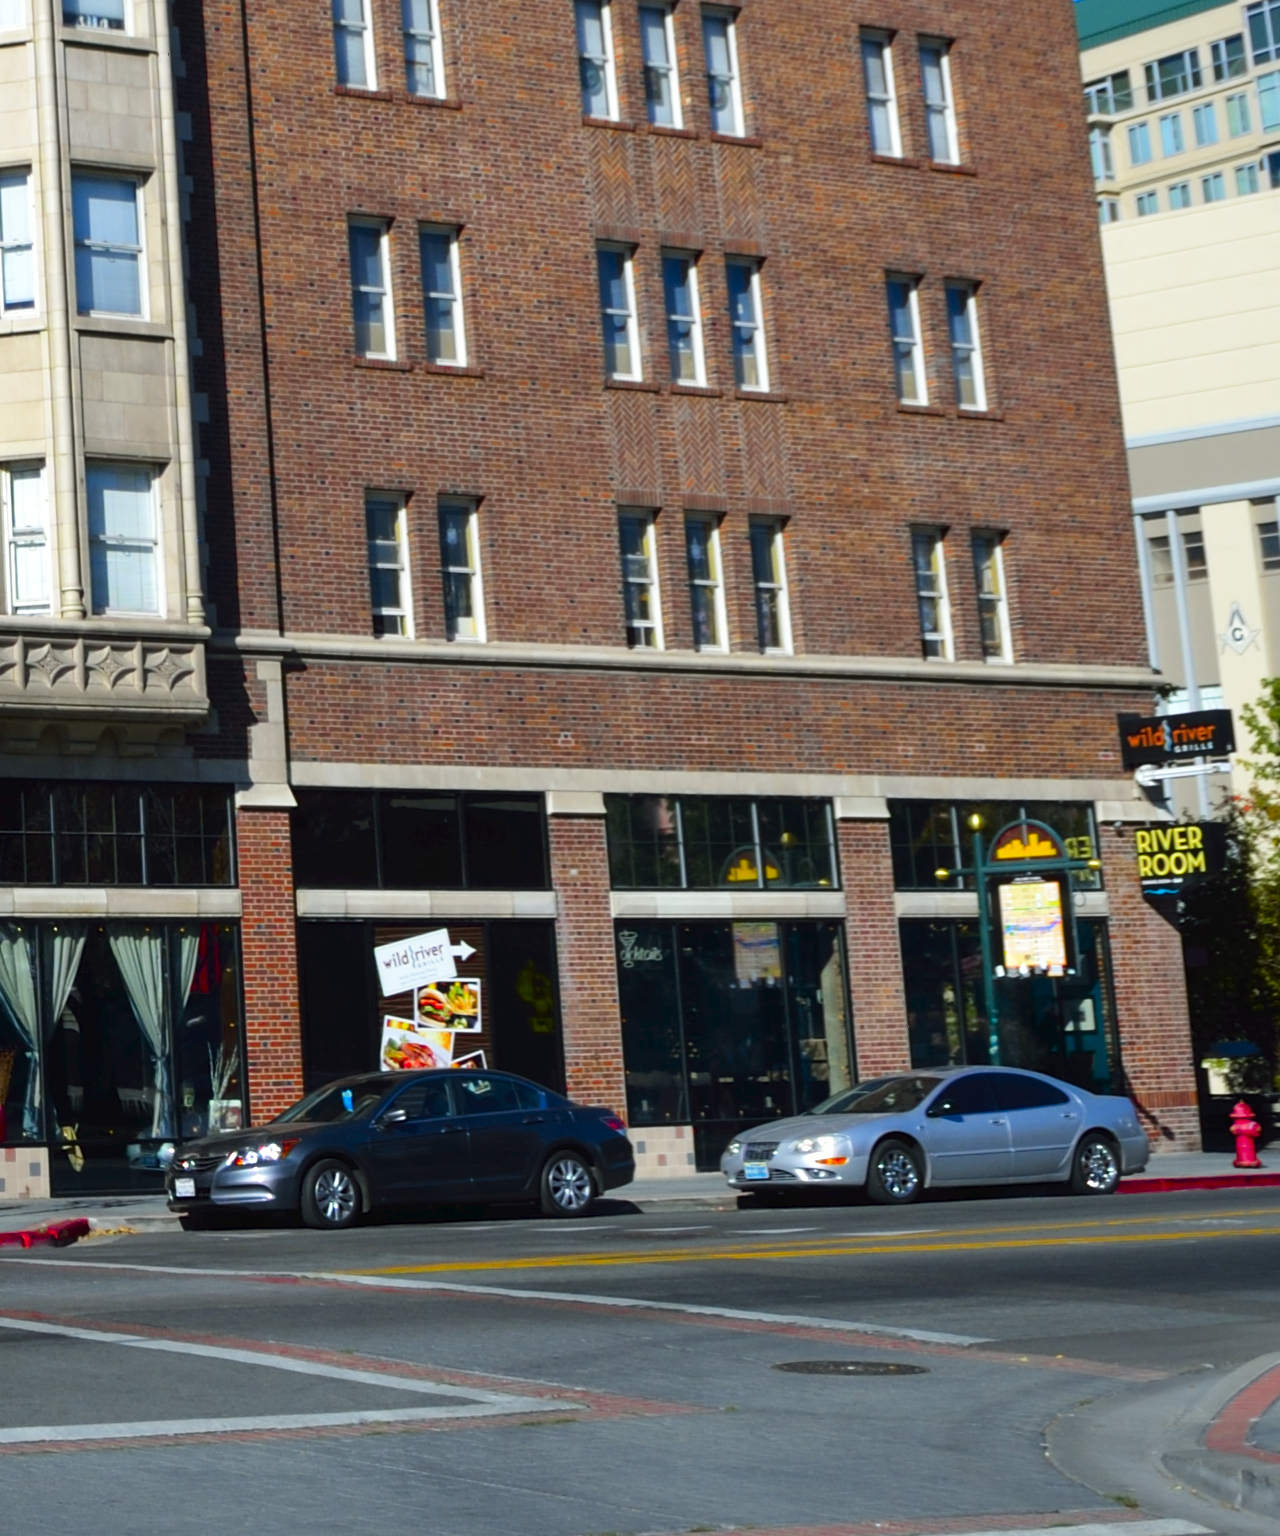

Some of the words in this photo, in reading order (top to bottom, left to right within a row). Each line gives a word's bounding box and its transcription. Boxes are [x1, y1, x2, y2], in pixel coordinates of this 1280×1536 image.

[1127, 725, 1164, 747] wild
[1172, 724, 1216, 743] river
[1136, 826, 1203, 853] RIVER
[1138, 851, 1207, 876] ROOM
[383, 949, 410, 969] wild
[414, 944, 444, 961] river
